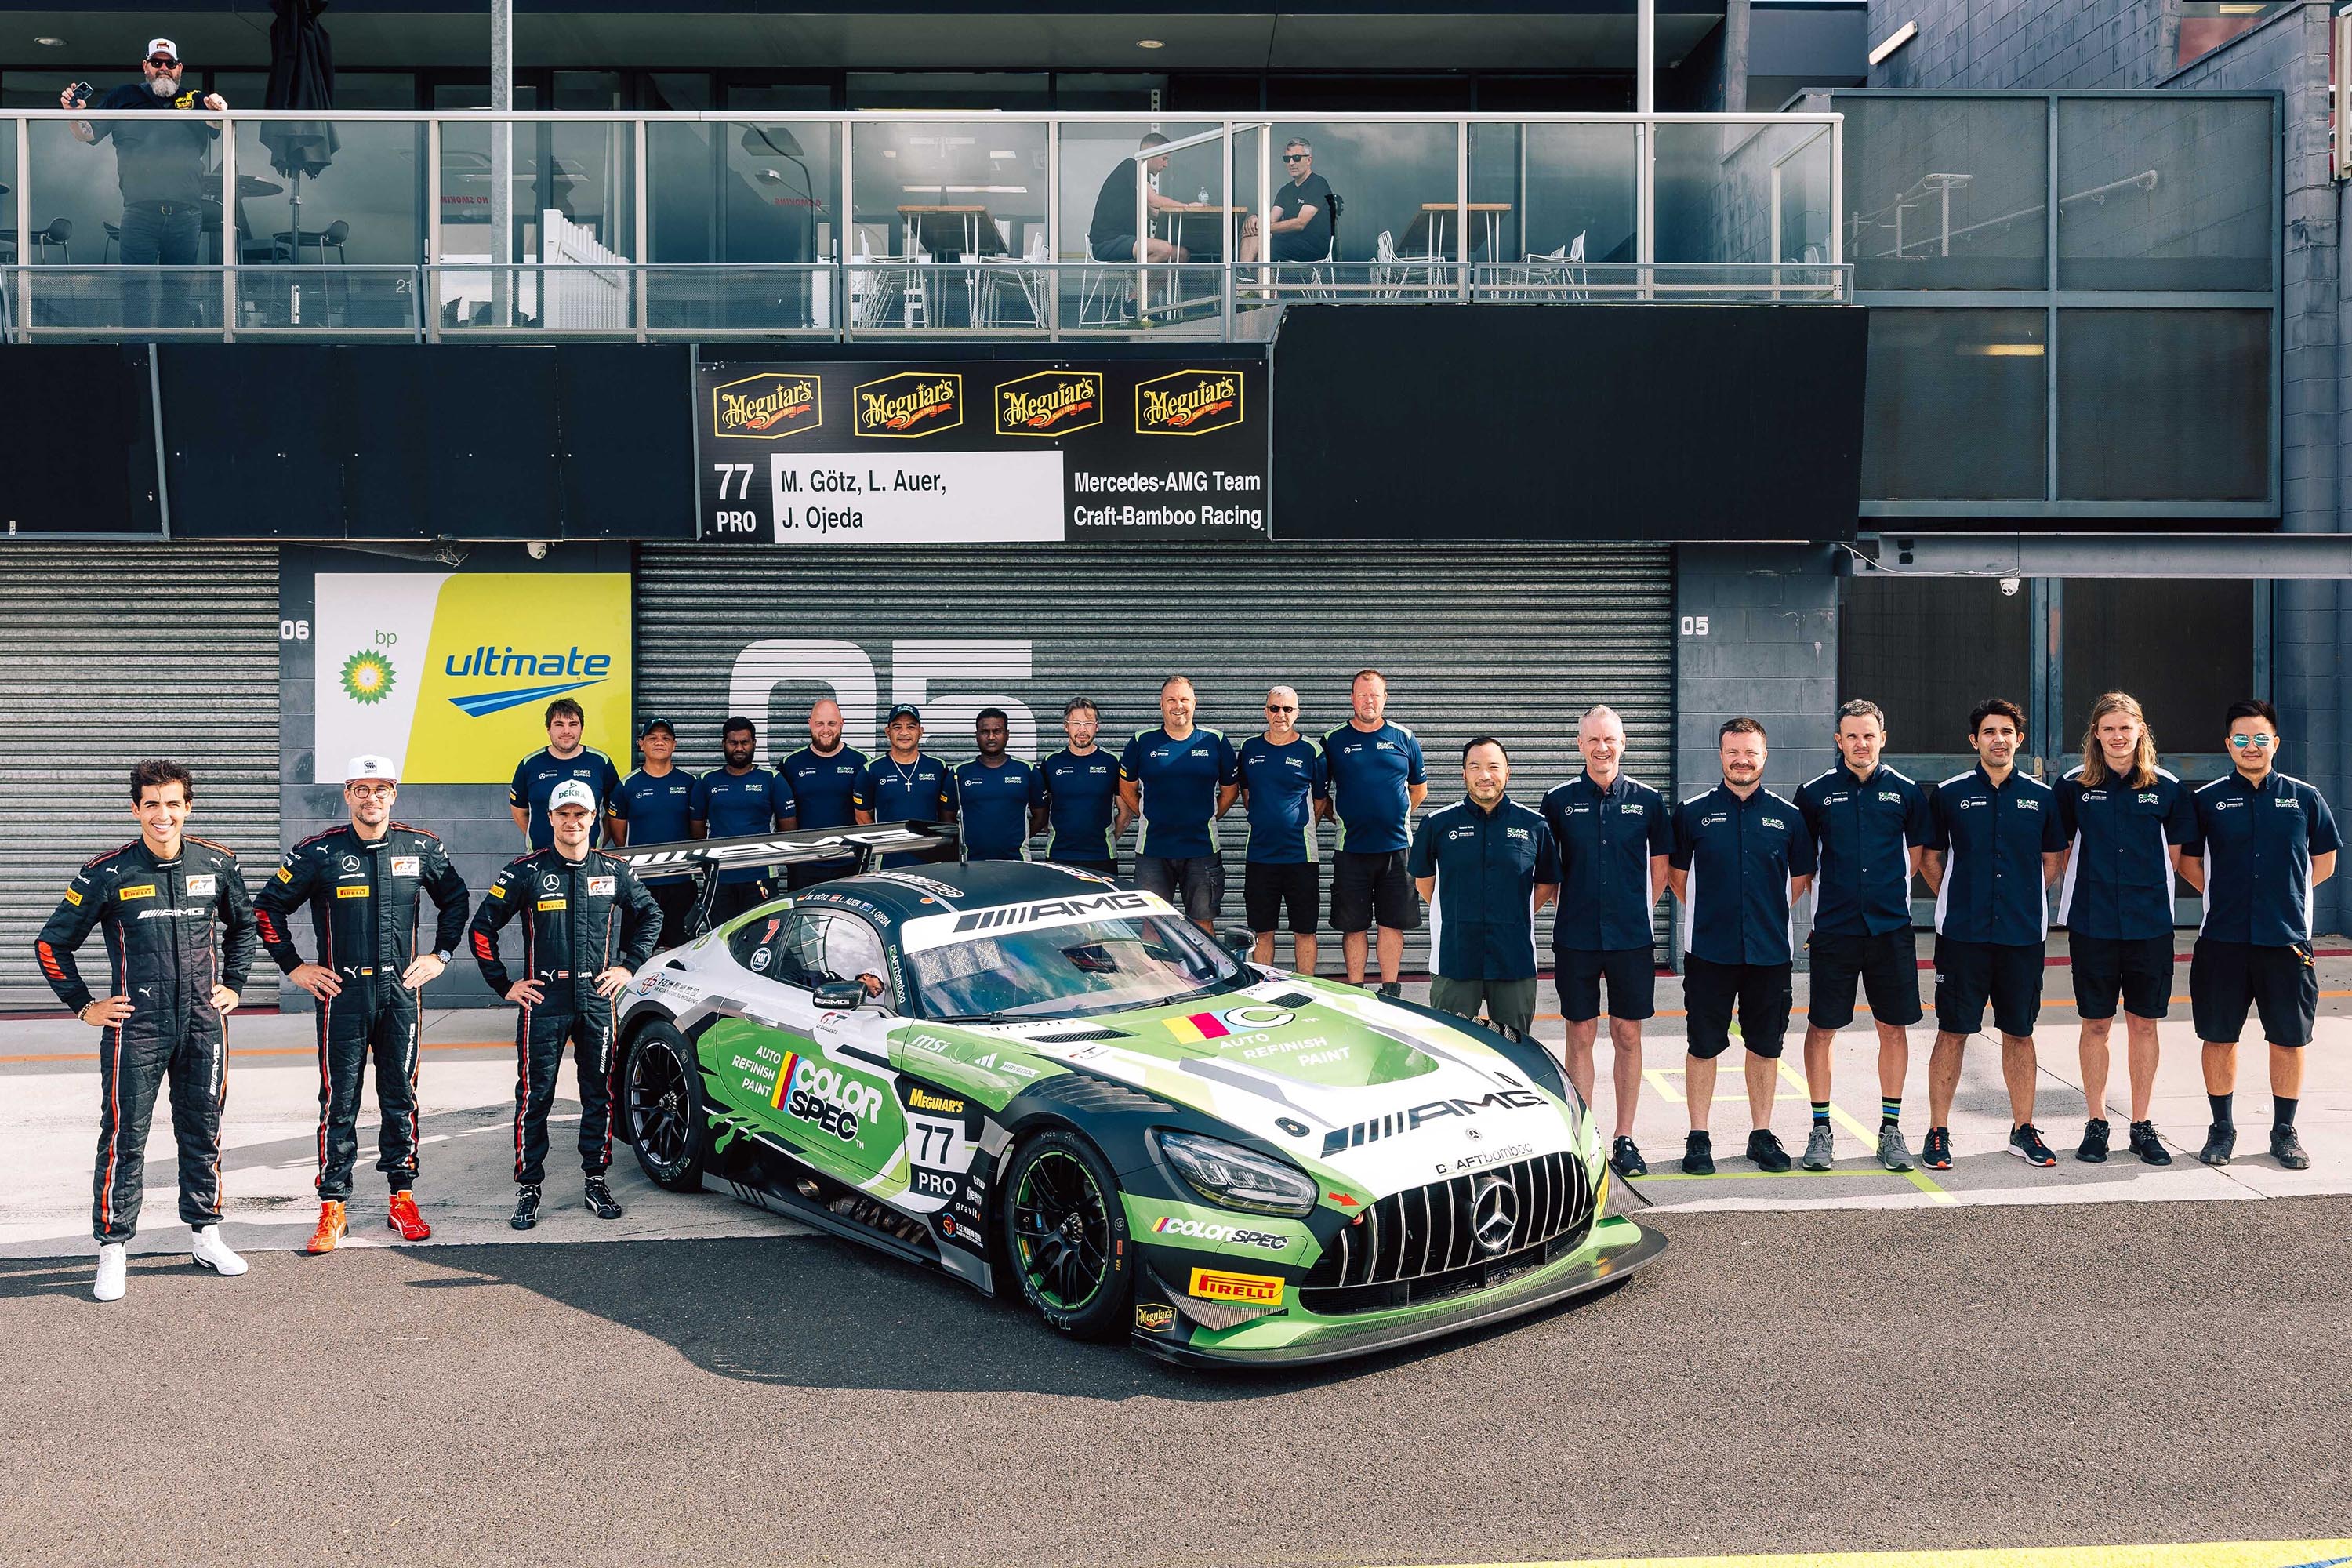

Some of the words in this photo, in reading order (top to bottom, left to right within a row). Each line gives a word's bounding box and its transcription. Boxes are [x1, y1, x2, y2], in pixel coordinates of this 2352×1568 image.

[722, 379, 814, 429] Meguiar's
[862, 379, 955, 429] Meguiar's
[1004, 377, 1095, 426] Meguiar's
[1143, 376, 1236, 426] Meguiar's
[714, 463, 755, 500] 77
[781, 470, 804, 492] M.
[810, 469, 862, 495] Götz,
[869, 470, 886, 492] L.
[893, 470, 947, 495] Auer,
[1074, 471, 1208, 492] Mercedes-AMG
[1212, 470, 1261, 492] Team
[717, 510, 757, 532] PRO
[782, 507, 800, 529] J.
[806, 506, 864, 534] Ojeda
[1073, 506, 1196, 526] Craft-Bamboo
[1201, 505, 1261, 530] Racing
[281, 619, 310, 641] 06
[1681, 616, 1709, 636] 05
[375, 629, 398, 648] bp
[445, 645, 612, 677] ultimate
[557, 788, 586, 800] DEKRA
[706, 828, 926, 858] AMG
[123, 887, 151, 898] PIRELLI
[161, 907, 205, 918] AMG
[844, 897, 862, 907] AUER
[874, 911, 891, 927] OJEDA
[754, 952, 768, 963] FOX
[909, 1033, 952, 1053] msi
[1219, 1033, 1270, 1050] AUTO
[1243, 1036, 1327, 1059] REFINISH
[755, 1045, 781, 1065] AUTO
[1298, 1046, 1350, 1067] PAINT
[731, 1054, 776, 1081] REFINISH
[741, 1077, 771, 1098] PAINT
[795, 1059, 884, 1125] COLOR
[787, 1088, 859, 1142] SPEC
[915, 1122, 955, 1165] 77
[918, 1171, 956, 1196] PRO
[956, 1202, 982, 1222] gravity
[1199, 1274, 1276, 1299] PIRELLI
[1138, 1308, 1173, 1326] Meguiar's
